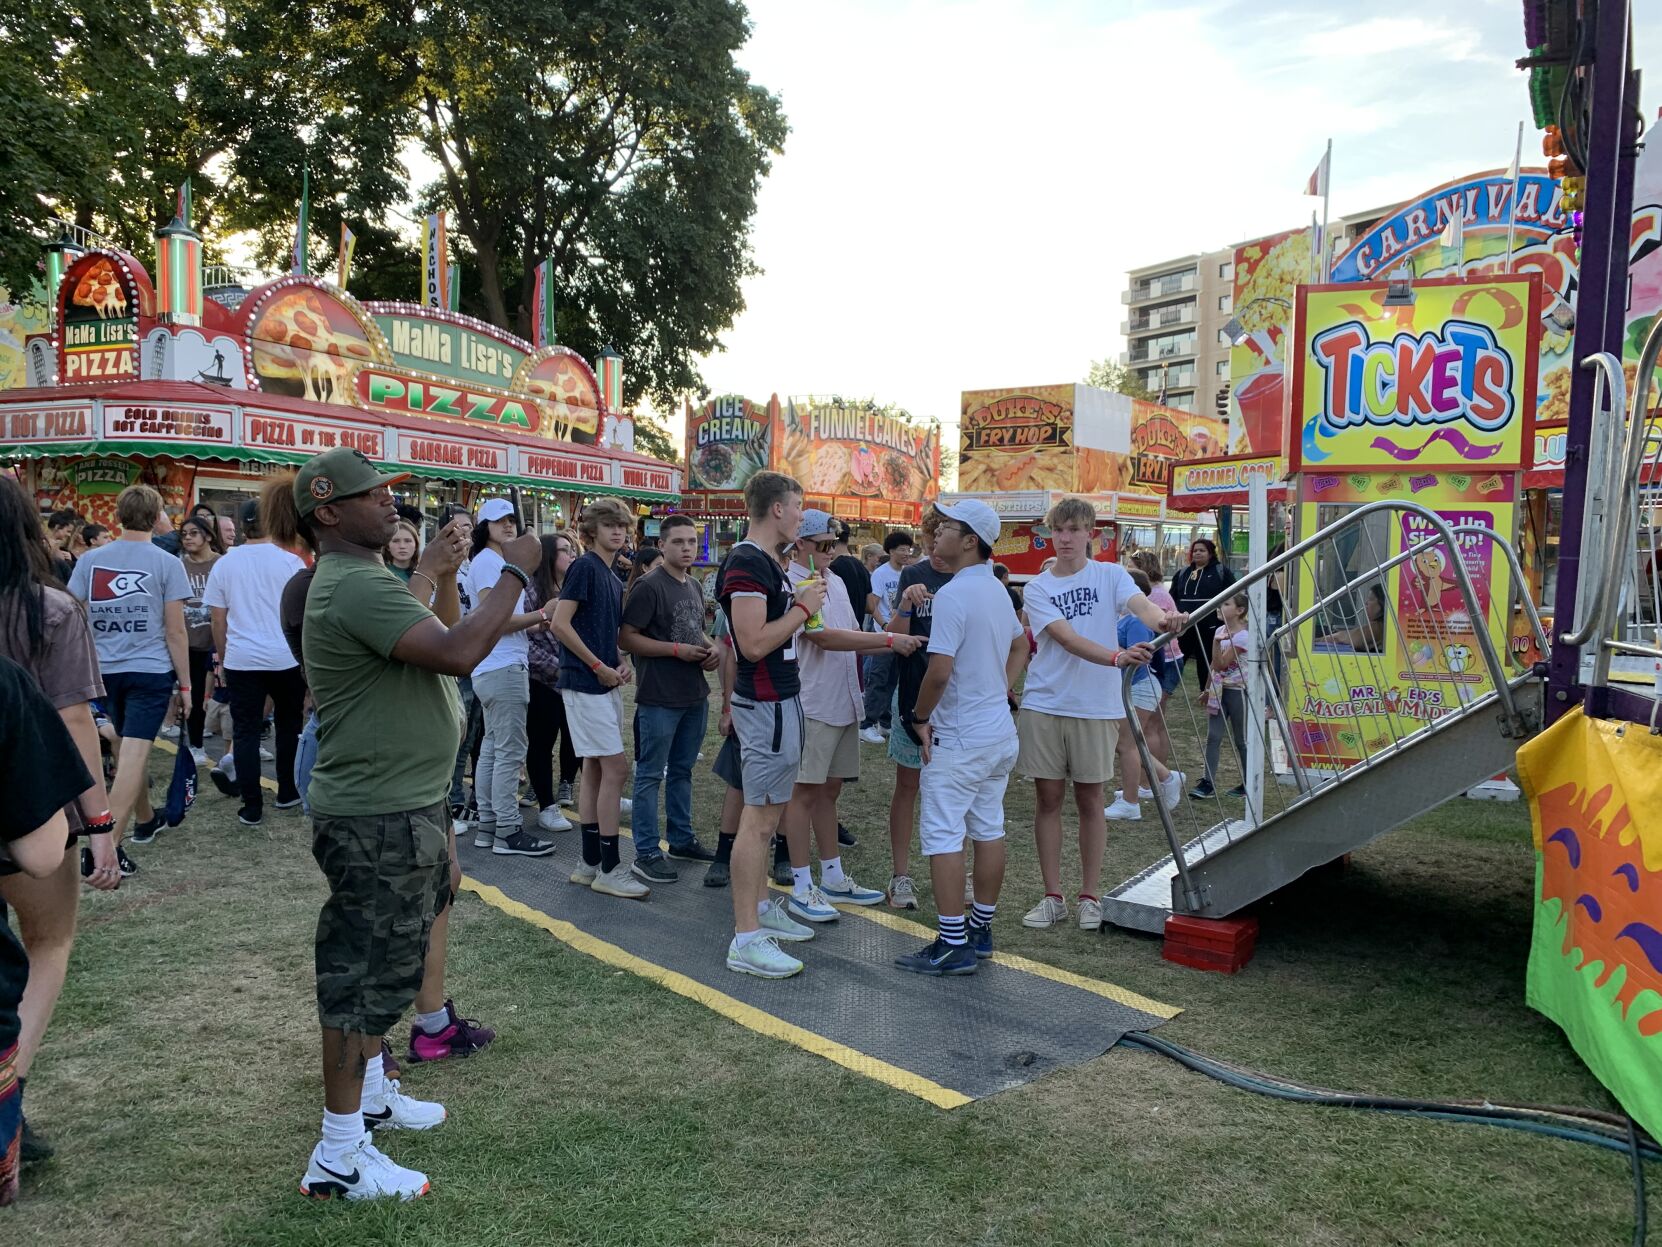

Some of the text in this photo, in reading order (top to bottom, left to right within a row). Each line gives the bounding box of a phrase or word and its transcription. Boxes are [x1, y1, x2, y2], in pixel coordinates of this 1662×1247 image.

[1356, 183, 1567, 277] CARNIVAL
[427, 228, 439, 307] NACHOS
[65, 323, 134, 345] MaMa Lisa's
[391, 319, 513, 379] MaMa Lisa's
[66, 350, 134, 378] PIZZA
[1317, 327, 1508, 423] TICKETS
[368, 373, 532, 430] PIZZA
[714, 394, 745, 417] ICE
[972, 398, 1063, 428] DUKE'S
[11, 413, 39, 438] HOT
[45, 411, 87, 437] PIZZA
[112, 420, 224, 438] HOT CAPPUCCINO
[124, 408, 212, 425] COLD DRINKS
[251, 418, 378, 455] PIZZA BY THE SLICE
[698, 417, 760, 445] CREAM
[810, 408, 917, 457] FUNNEL CAKES
[979, 426, 1053, 446] FRY HOP
[1134, 416, 1188, 460] DUKE'S
[410, 439, 498, 469] SAUSAGE PIZZA
[78, 469, 129, 486] PIZZA
[527, 455, 605, 482] PEPPERONI PIZZA
[623, 469, 670, 489] WHOLE PIZZA
[1139, 456, 1159, 481] FRY
[1187, 466, 1238, 488] CARAMEL
[115, 577, 129, 591] G
[91, 606, 122, 614] LAKE
[1050, 587, 1100, 608] RIVIERA
[1351, 686, 1443, 704] MR. ED'S
[1303, 698, 1385, 719] MAGICAL
